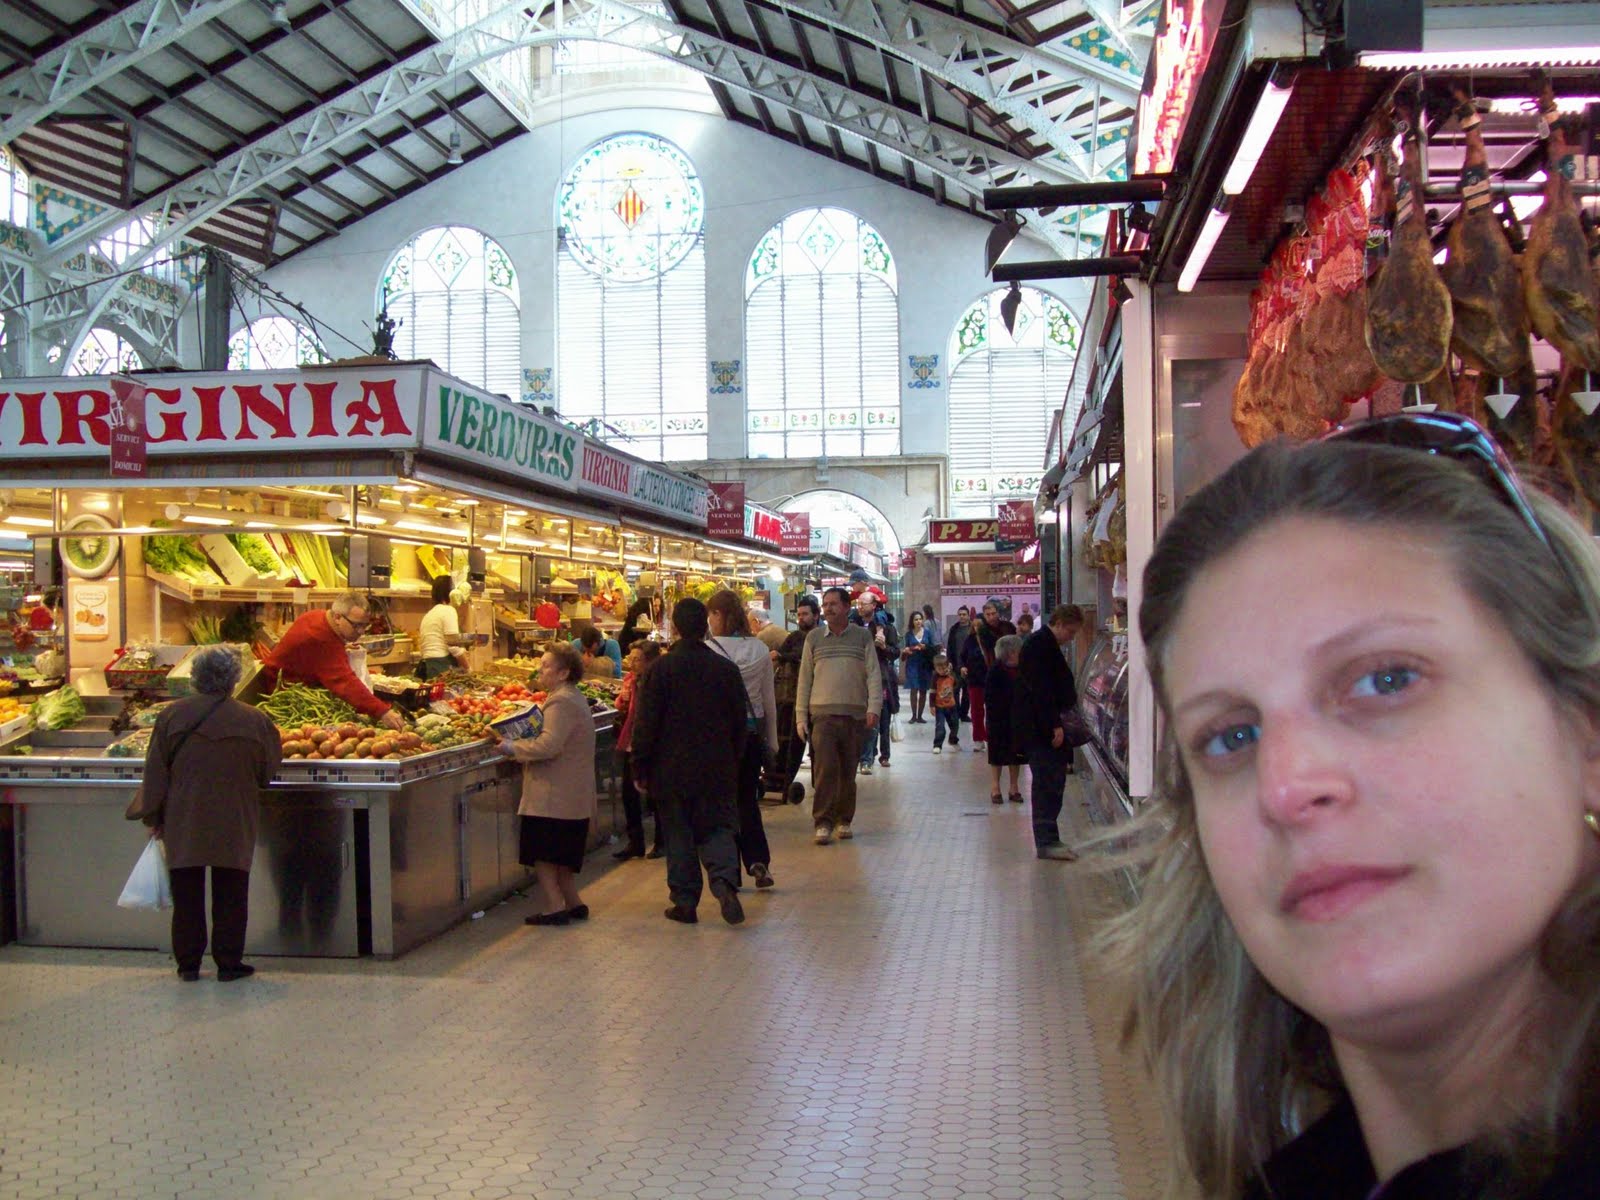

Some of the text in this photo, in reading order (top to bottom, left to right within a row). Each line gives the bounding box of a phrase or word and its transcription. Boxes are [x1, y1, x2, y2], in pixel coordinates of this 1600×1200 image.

[0, 379, 413, 446] IRGINIA
[116, 433, 140, 444] SERVICI
[439, 384, 577, 482] VERDURAS
[114, 461, 142, 472] DOMICILI
[581, 446, 631, 495] VIRGINIA
[938, 523, 962, 540] P.
